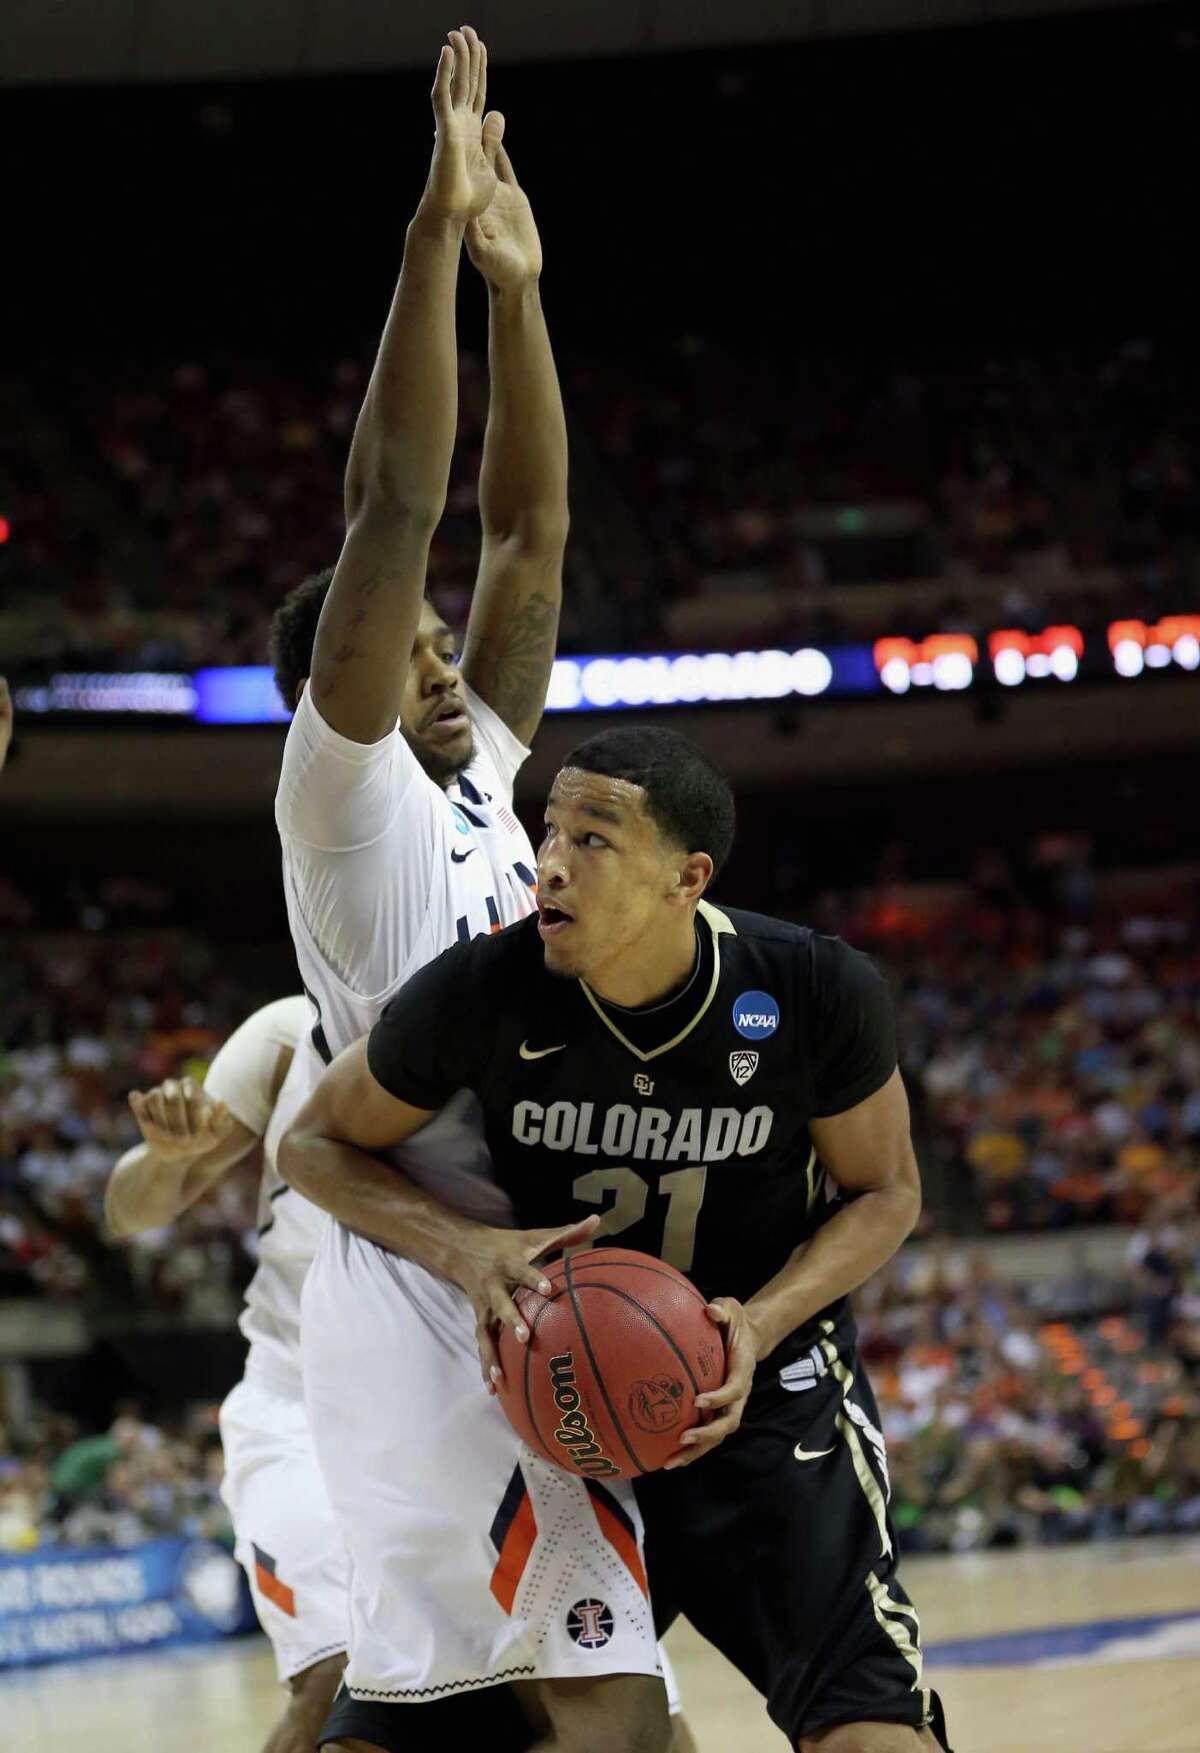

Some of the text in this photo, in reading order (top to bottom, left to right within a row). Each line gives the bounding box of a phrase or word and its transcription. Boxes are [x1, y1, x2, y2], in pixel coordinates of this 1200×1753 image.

[739, 1014, 776, 1028] NCAA
[732, 1053, 758, 1072] PAC
[735, 1066, 750, 1079] 12
[512, 1100, 774, 1161] COLORADO
[562, 1165, 707, 1272] 21
